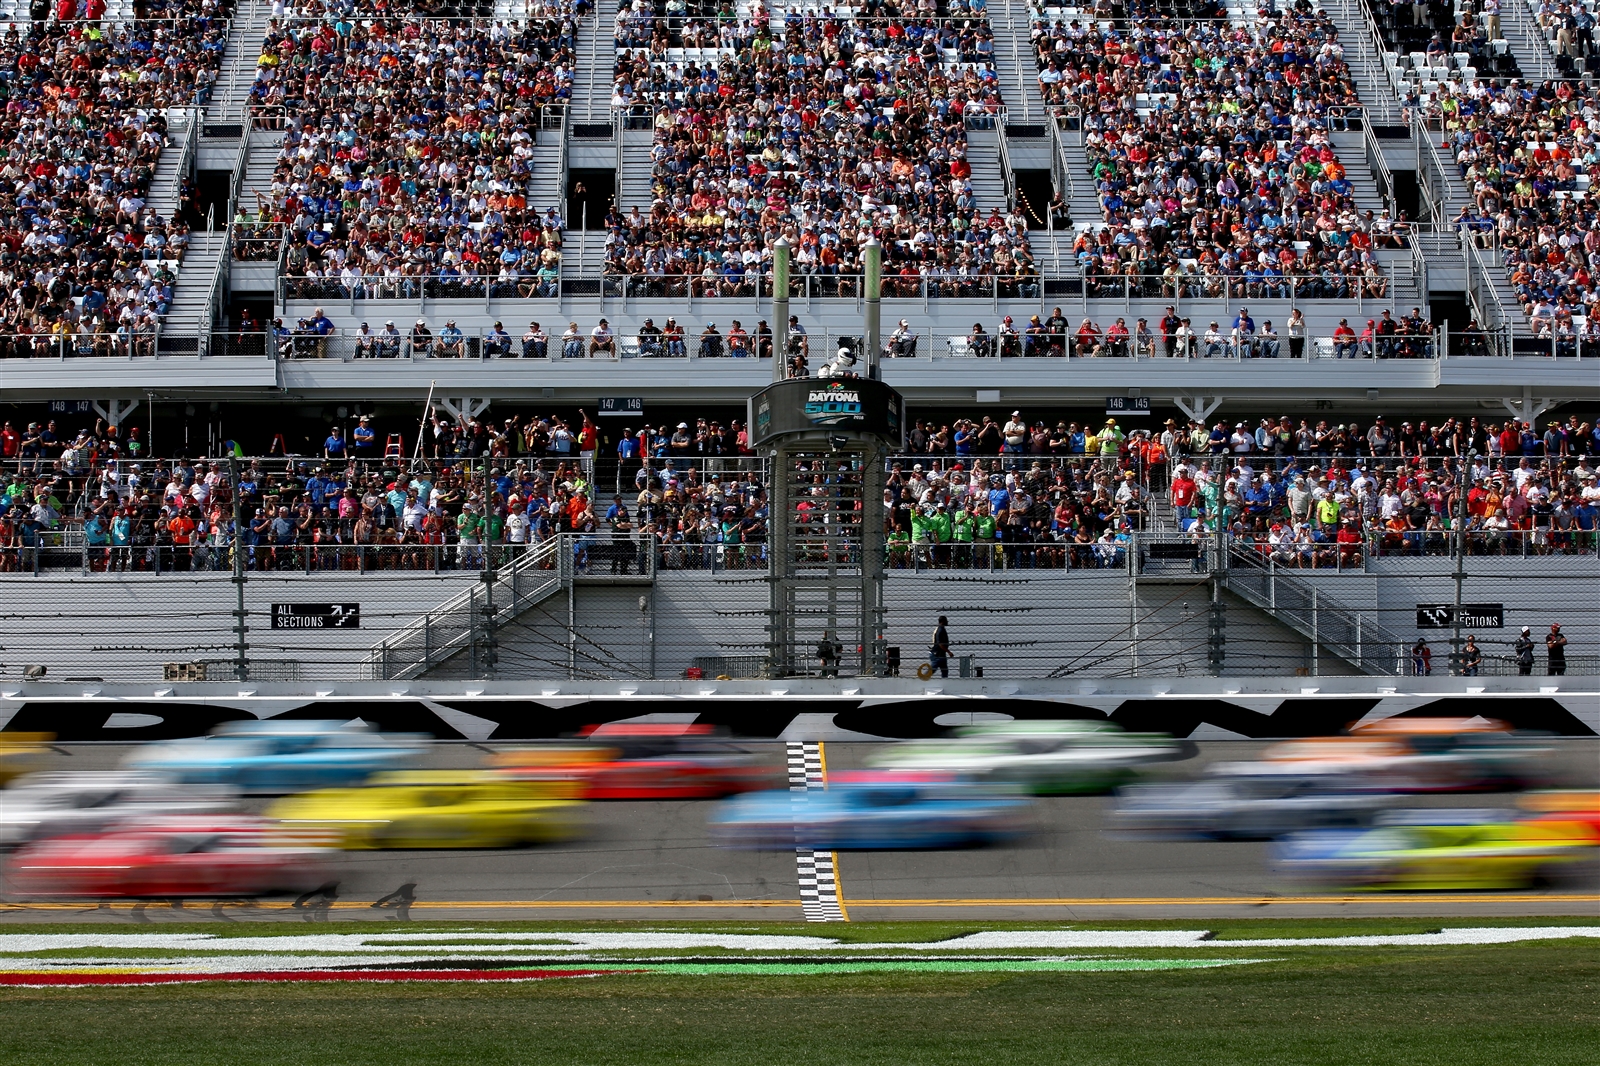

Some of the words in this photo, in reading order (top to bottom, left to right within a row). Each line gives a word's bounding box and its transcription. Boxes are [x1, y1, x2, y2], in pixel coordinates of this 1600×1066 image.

[808, 393, 860, 402] DAYTONA
[1110, 398, 1123, 408] 146
[1135, 398, 1148, 408] 145
[51, 401, 65, 411] 148
[76, 401, 89, 411] 147
[602, 398, 615, 409] 147
[627, 398, 641, 409] 146
[805, 402, 861, 413] 500
[277, 604, 294, 615] ALL
[277, 616, 324, 627] SECTIONS
[1459, 616, 1499, 627] ECTIONS
[0, 697, 1600, 741] DAYTONA
